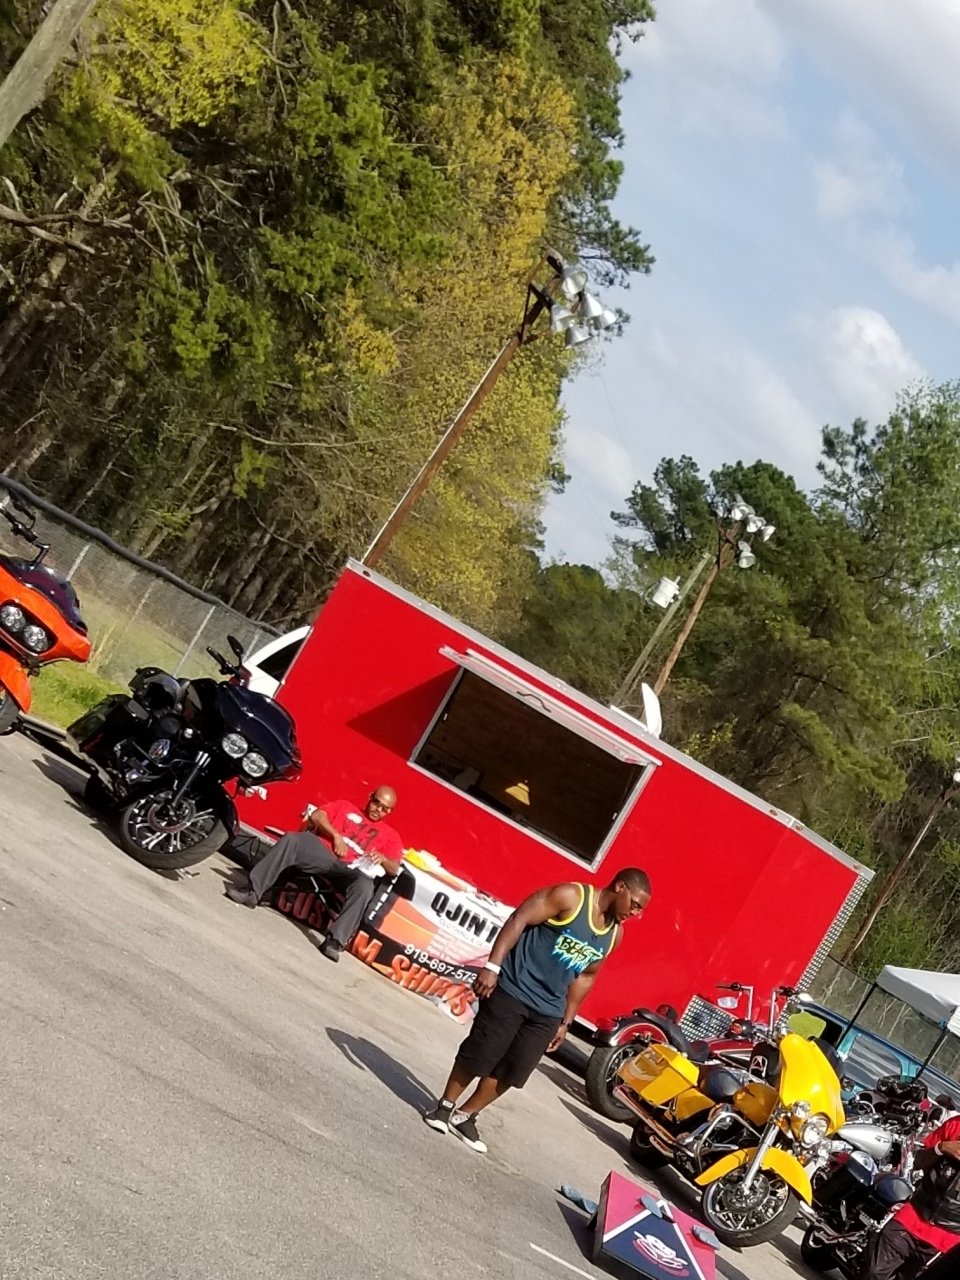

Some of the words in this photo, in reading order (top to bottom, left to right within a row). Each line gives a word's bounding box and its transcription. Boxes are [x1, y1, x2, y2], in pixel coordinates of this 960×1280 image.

[431, 892, 501, 944] QJINT
[404, 944, 478, 983] 919-697-573
[555, 934, 603, 963] BEAST
